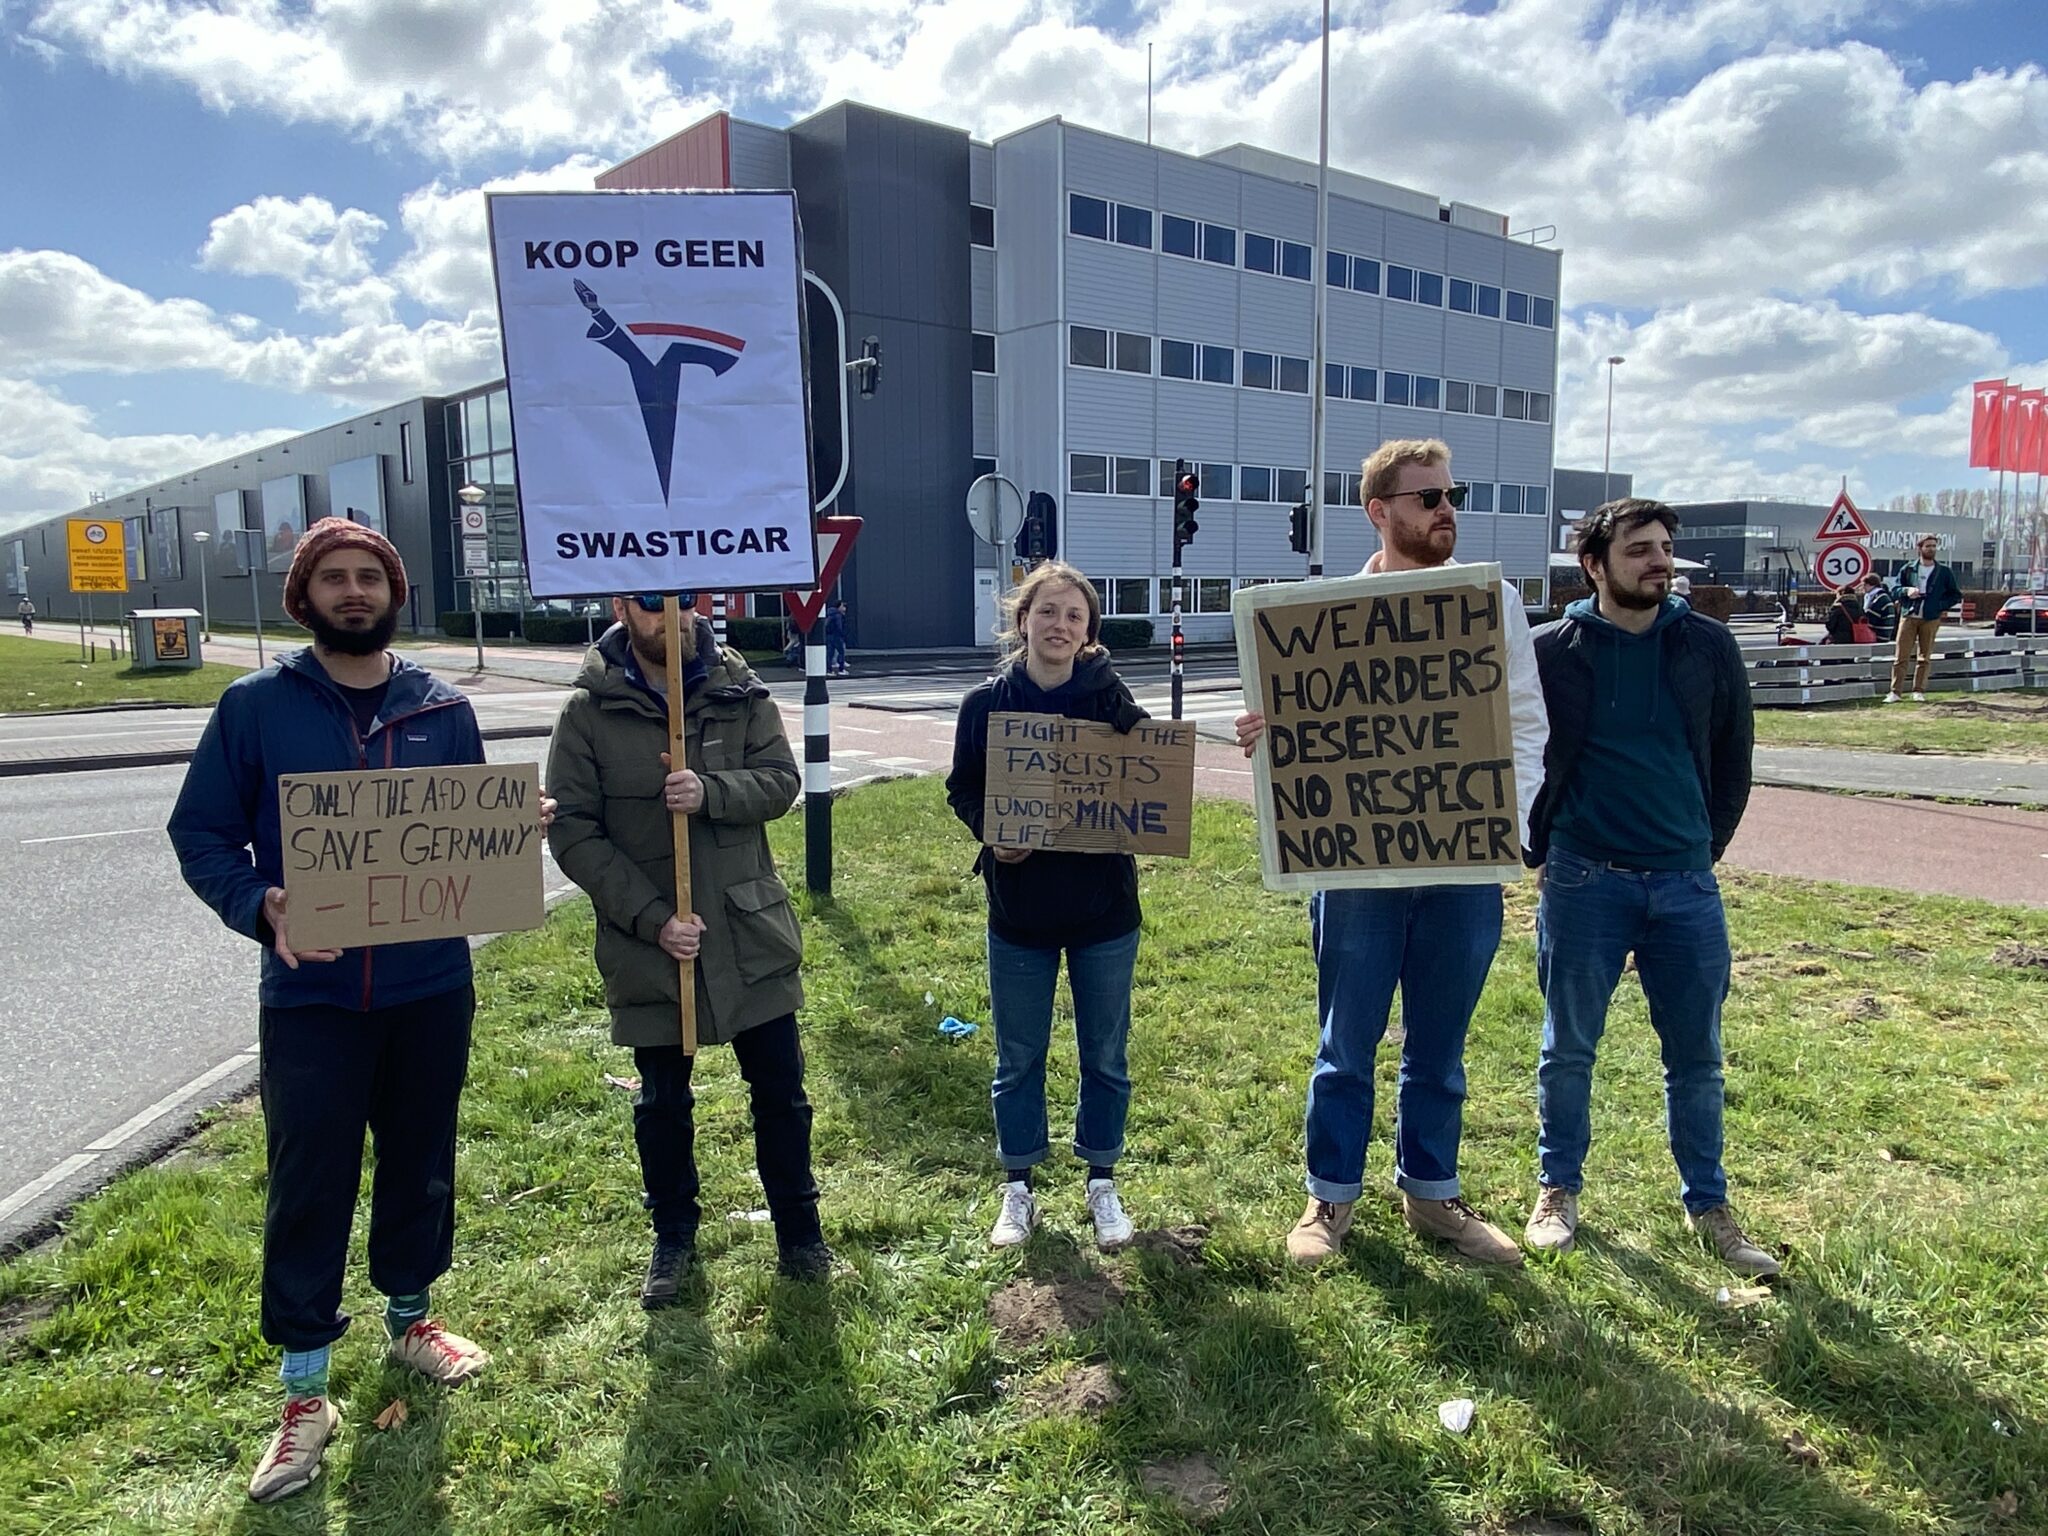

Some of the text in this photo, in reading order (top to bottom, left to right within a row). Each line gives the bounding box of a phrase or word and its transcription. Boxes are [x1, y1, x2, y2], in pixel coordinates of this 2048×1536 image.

[524, 239, 764, 269] KOOP GEEN
[556, 526, 790, 559] SWASTICAR
[1827, 557, 1861, 576] 30
[1257, 592, 1498, 658] WEALTH
[1271, 644, 1502, 714] HOARDERS
[1004, 719, 1189, 746] FIGHT THE
[1270, 711, 1460, 768] DESERVE
[1004, 747, 1161, 784] FASCISTS
[371, 777, 414, 818] THE
[477, 776, 526, 810] CAN
[1058, 779, 1110, 796] THAT
[1272, 758, 1511, 821] NO RESPECT
[994, 797, 1168, 835] UNDERMINE
[996, 822, 1056, 847] LIFE
[291, 827, 382, 872] SAVE
[1278, 816, 1517, 873] NOR POWER
[368, 874, 471, 927] ELON
